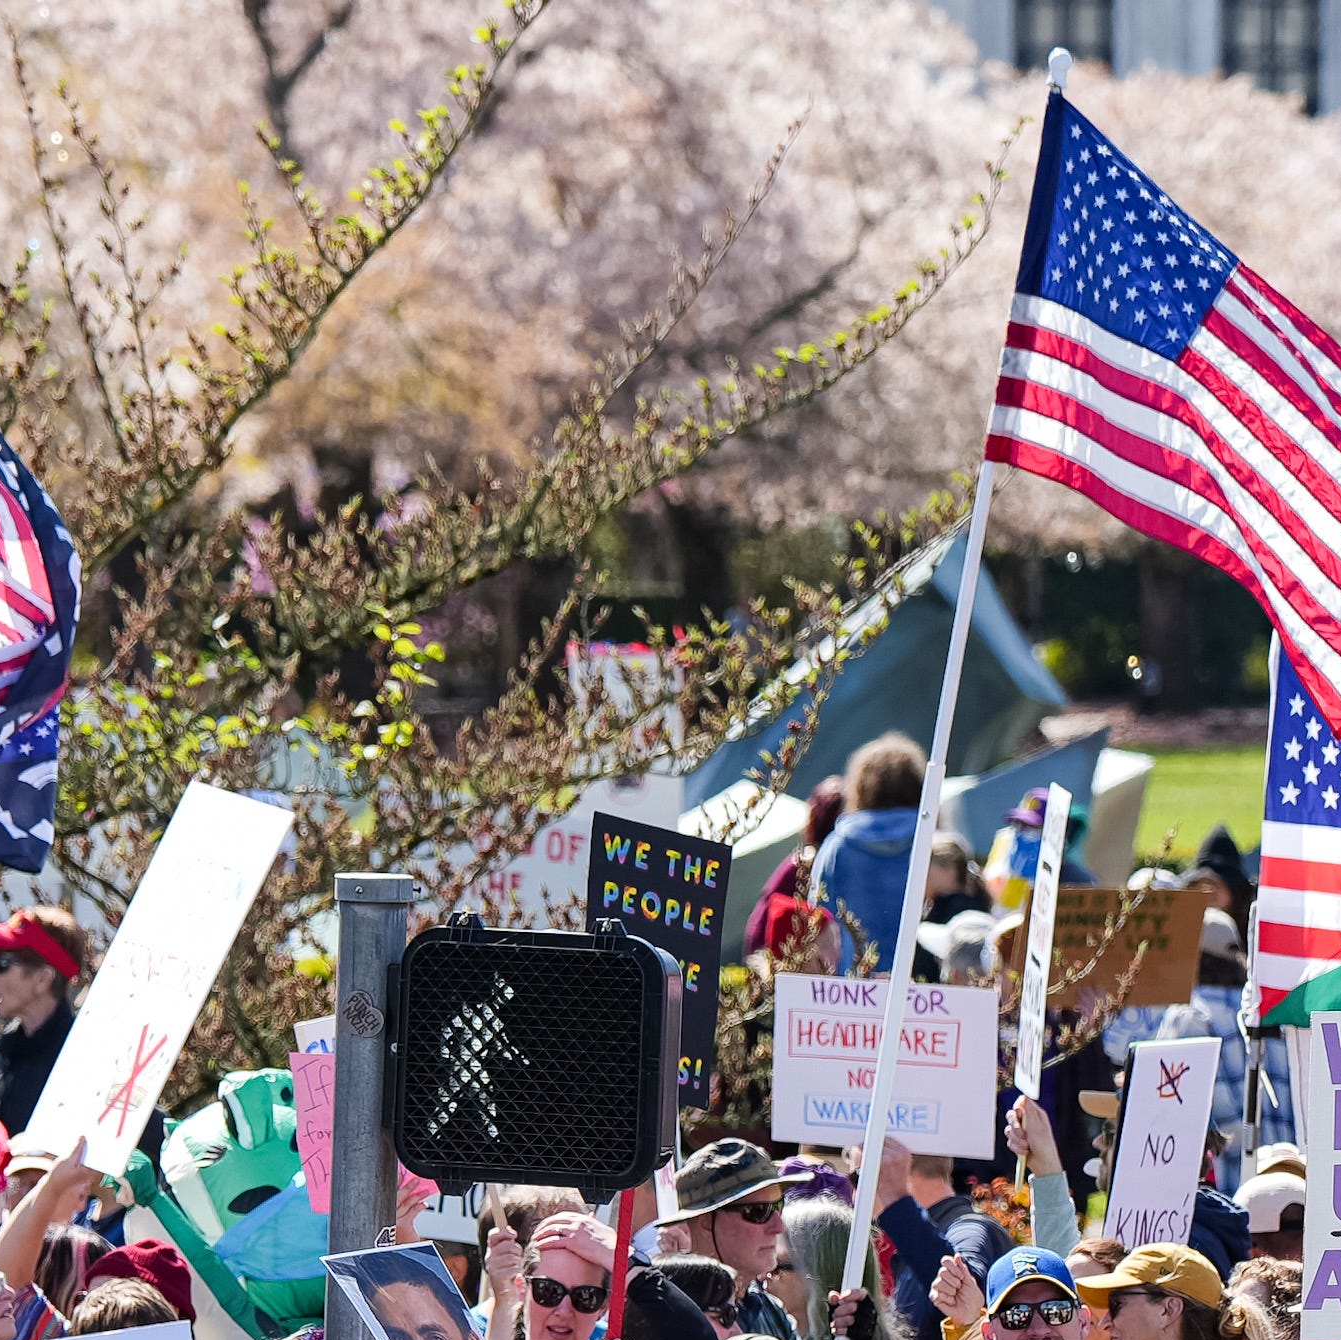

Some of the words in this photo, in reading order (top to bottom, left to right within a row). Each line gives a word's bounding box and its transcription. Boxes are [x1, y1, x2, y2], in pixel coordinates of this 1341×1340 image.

[603, 832, 651, 870] WE
[665, 849, 720, 889] THE
[602, 880, 715, 937] PEOPLE
[812, 981, 877, 1007] HONK
[343, 1007, 369, 1035] NAZIS
[347, 995, 380, 1031] PUNCH
[798, 1019, 948, 1057] HEALTHARE
[1140, 1133, 1176, 1168] NO
